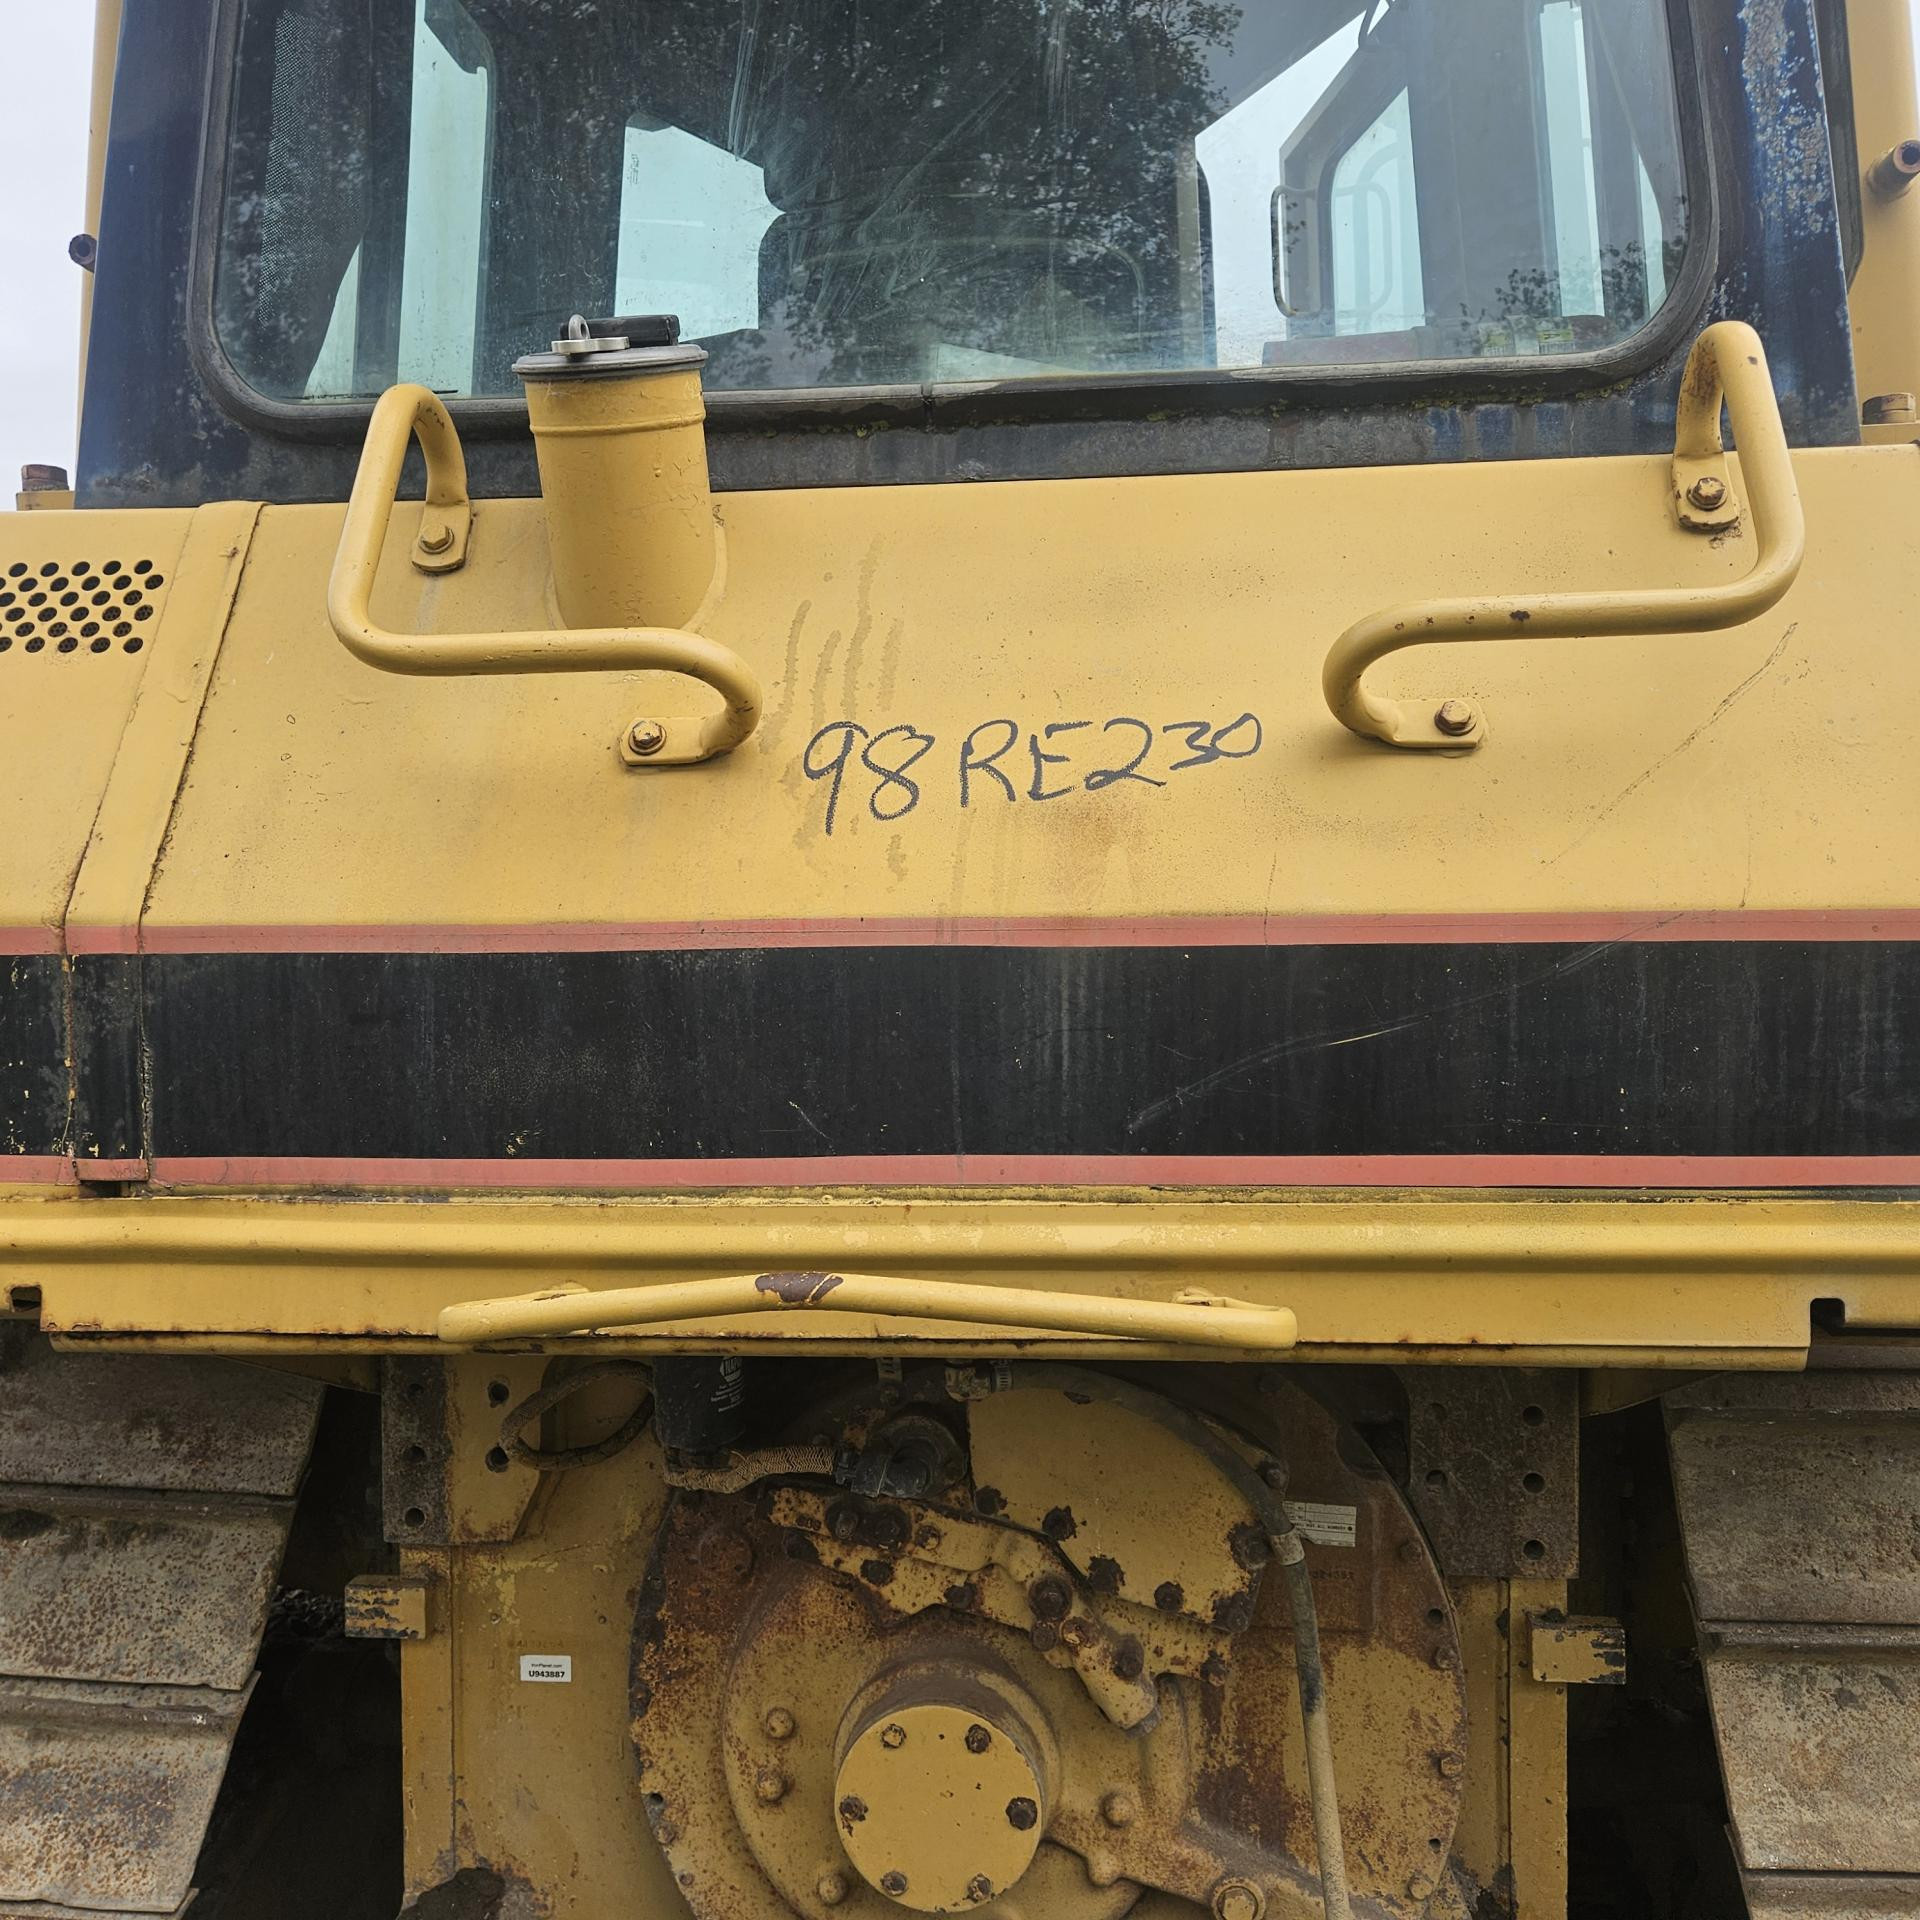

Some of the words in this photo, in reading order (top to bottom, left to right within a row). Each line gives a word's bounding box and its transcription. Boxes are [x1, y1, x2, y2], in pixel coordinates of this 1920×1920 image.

[804, 721, 936, 836] 98
[960, 712, 1263, 808] RE230
[528, 1670, 565, 1678] U943887
